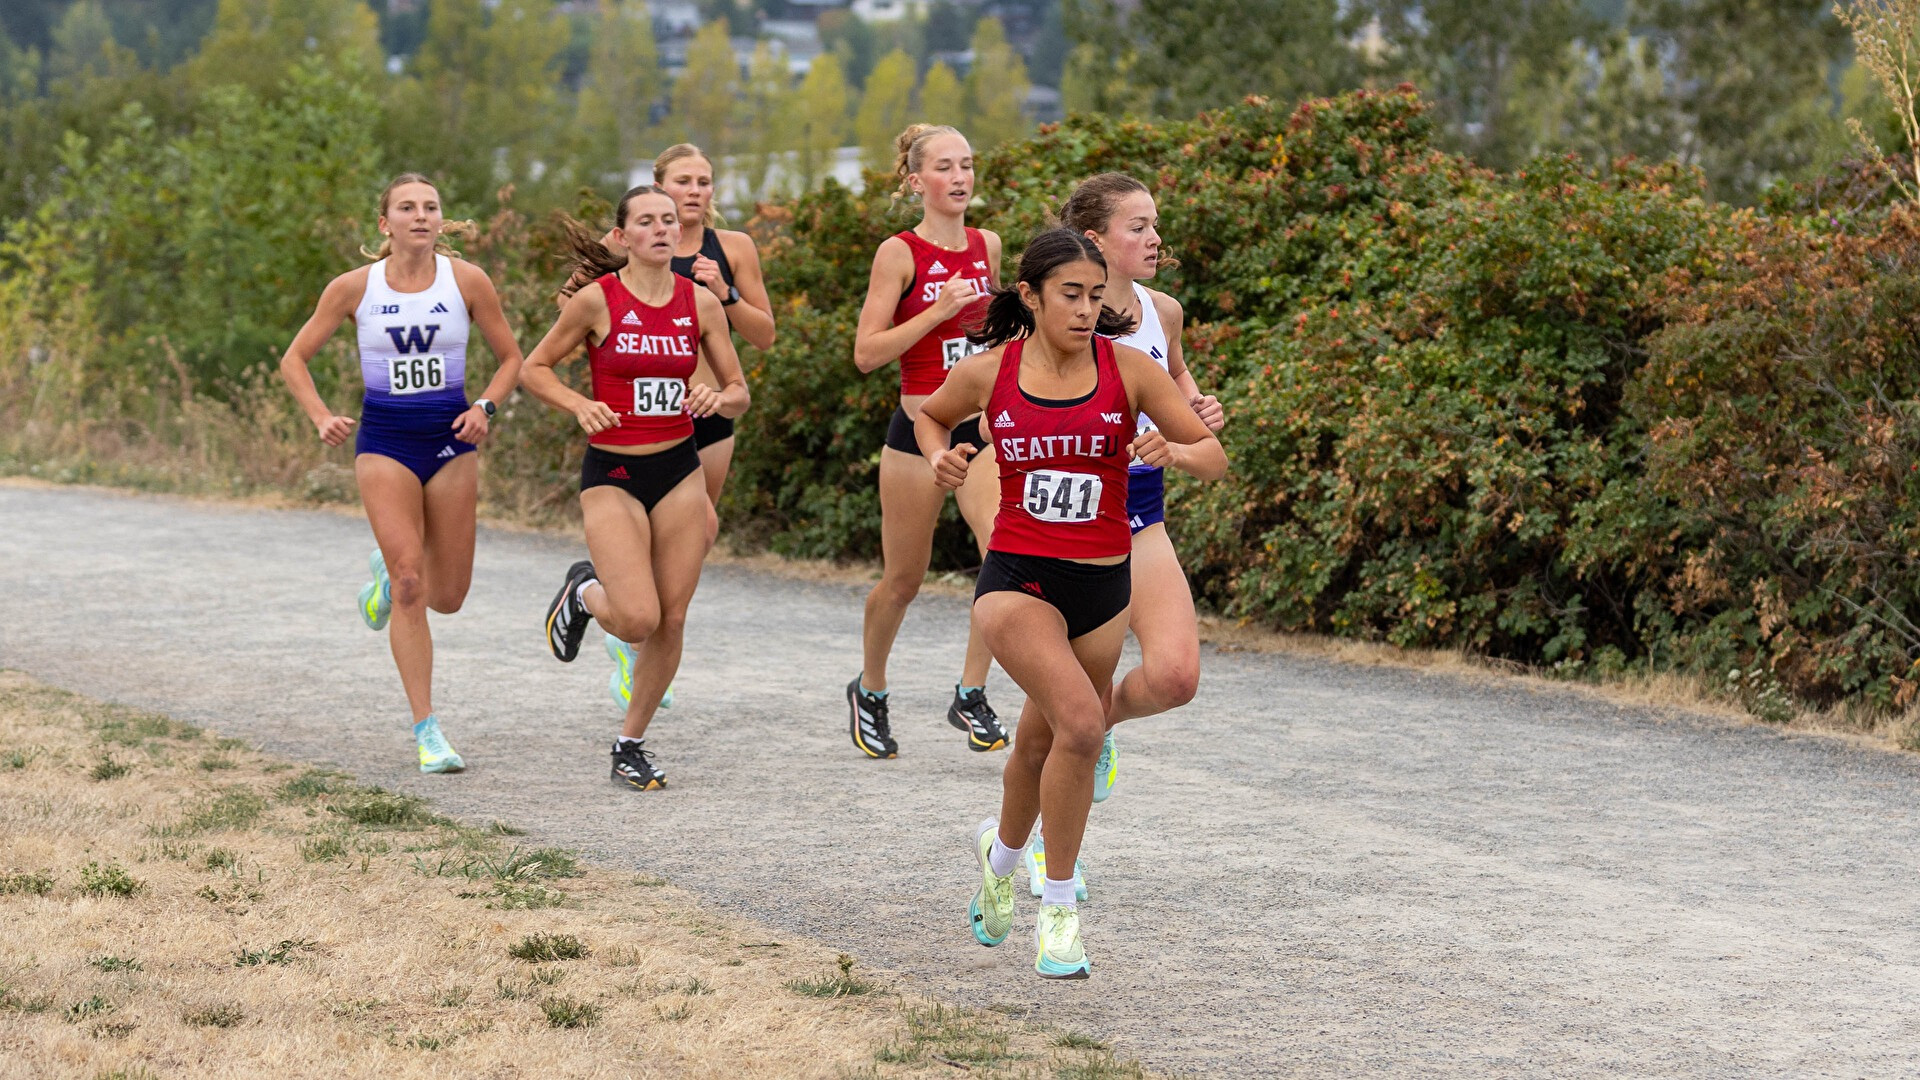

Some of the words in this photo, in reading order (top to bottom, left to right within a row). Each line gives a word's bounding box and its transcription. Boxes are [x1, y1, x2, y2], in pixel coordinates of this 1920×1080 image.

[385, 325, 440, 354] W
[393, 358, 442, 390] 566
[638, 381, 682, 413] 542
[994, 420, 1015, 428] adidas
[1028, 473, 1095, 519] 541
